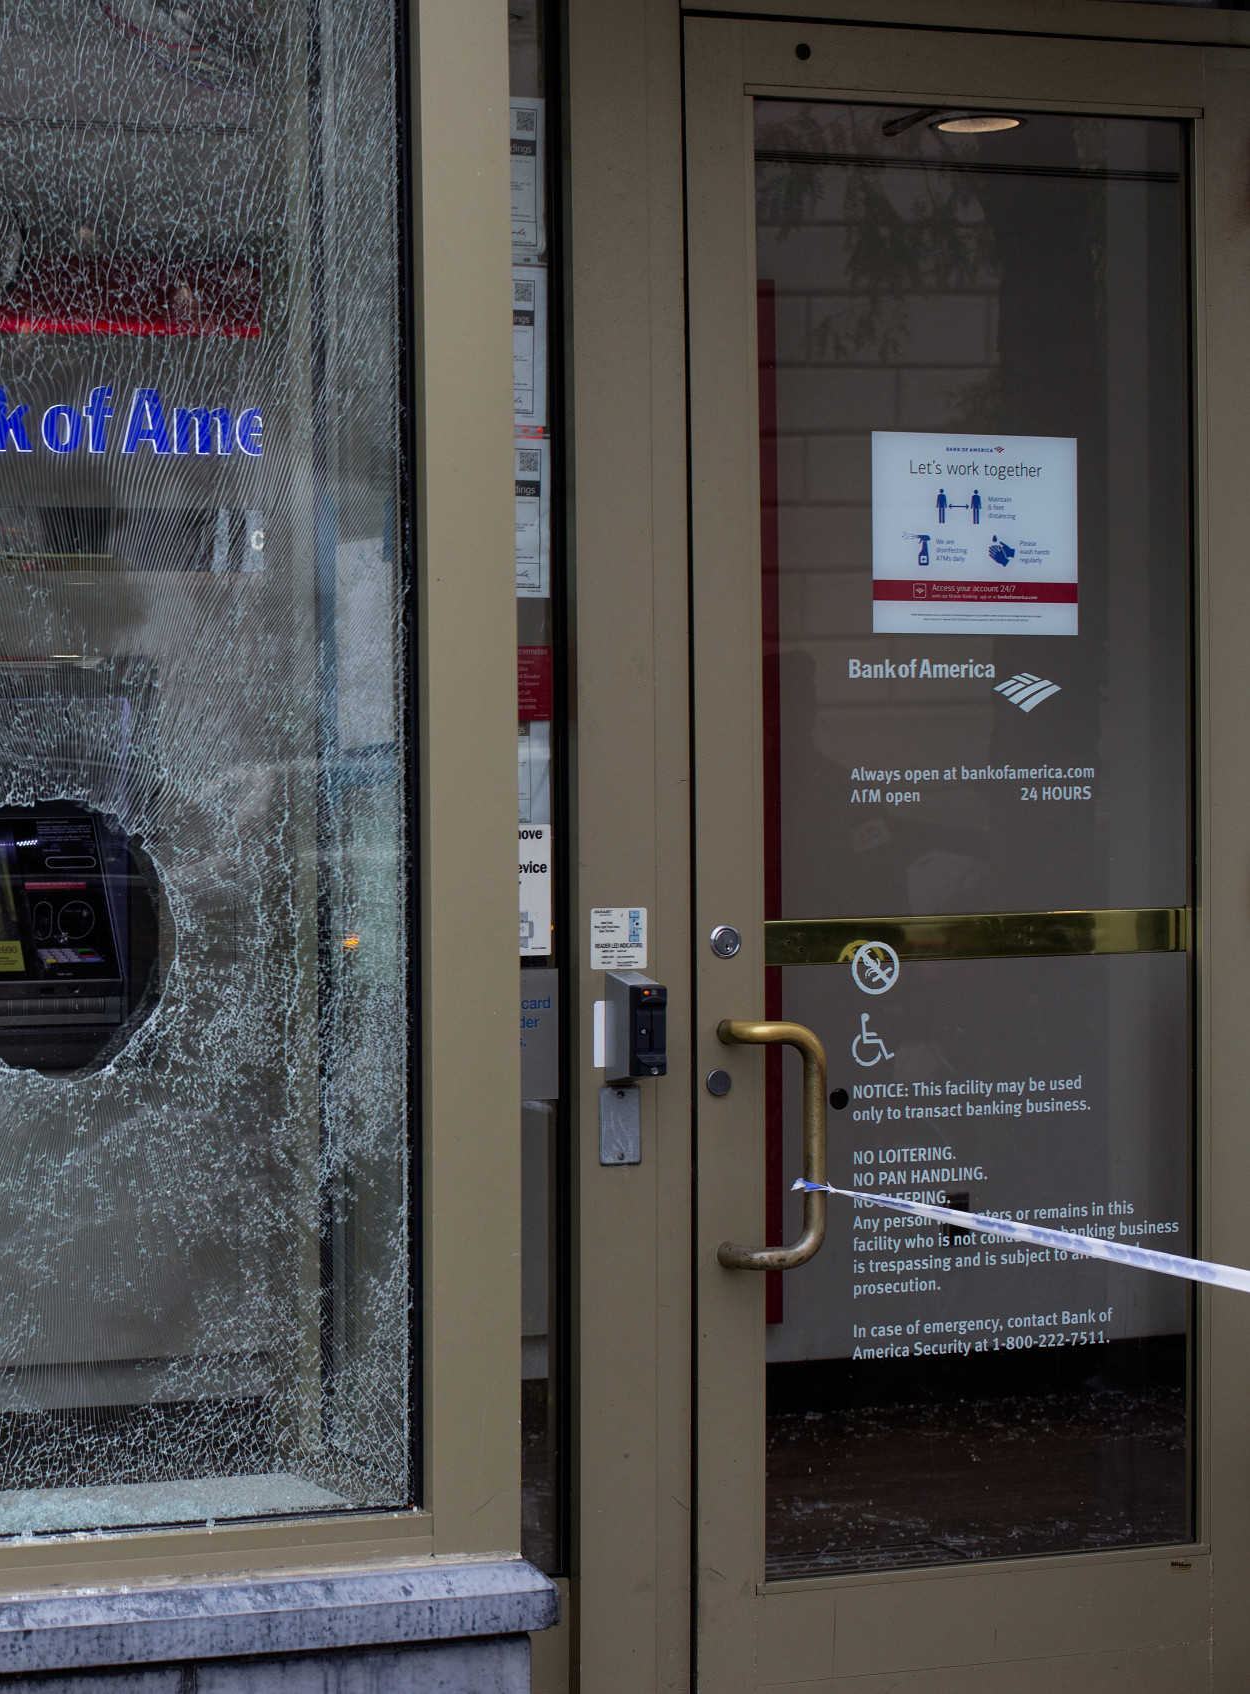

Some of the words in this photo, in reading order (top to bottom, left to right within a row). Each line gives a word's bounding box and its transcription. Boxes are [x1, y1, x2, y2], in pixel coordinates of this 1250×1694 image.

[41, 384, 113, 456] of
[910, 460, 942, 474] Let's
[947, 462, 979, 475] work
[984, 463, 1041, 480] together
[932, 584, 955, 592] Access
[849, 659, 896, 678] Bank
[898, 659, 917, 678] of
[919, 659, 995, 678] America
[851, 767, 900, 784] Always
[905, 770, 939, 784] open
[944, 767, 957, 780] at
[962, 765, 1094, 779] bankofamerica.com
[886, 792, 920, 805] open
[1021, 788, 1038, 800] 24
[1043, 786, 1091, 800] HOURS
[522, 996, 551, 1011] card
[854, 1084, 908, 1098] NOTICE:
[913, 1082, 941, 1096] This
[946, 1080, 993, 1097] facility
[997, 1082, 1025, 1095] may
[1030, 1077, 1045, 1091] be
[1050, 1075, 1081, 1090] used
[853, 1106, 883, 1123] only
[887, 1107, 901, 1119] to
[905, 1104, 962, 1118] transact
[967, 1100, 1022, 1117] banking
[1027, 1098, 1090, 1113] business.
[854, 1151, 874, 1164] NO
[879, 1147, 956, 1163] LOITERING.
[854, 1172, 874, 1186] NO
[879, 1171, 906, 1185] PAN
[912, 1167, 987, 1183] HANDLING.
[853, 1216, 880, 1232] Any
[884, 1217, 931, 1235] person
[1016, 1210, 1030, 1220] or
[1034, 1204, 1087, 1219] remains
[1092, 1202, 1103, 1216] in
[1108, 1200, 1134, 1215] this
[854, 1236, 901, 1253] facility
[905, 1234, 933, 1248] who
[939, 1233, 949, 1246] is
[954, 1232, 976, 1245] not
[1120, 1220, 1179, 1235] business
[854, 1259, 865, 1273] is
[869, 1250, 951, 1274] trespassing
[956, 1252, 980, 1267] and
[986, 1252, 996, 1265] is
[1001, 1246, 1051, 1266] subject
[1054, 1247, 1068, 1262] to
[854, 1277, 940, 1298] prosecution.
[854, 1325, 866, 1337] In
[871, 1325, 902, 1337] case
[907, 1320, 920, 1334] of
[924, 1319, 1003, 1334] emergency,
[1008, 1313, 1057, 1328] contact
[1062, 1309, 1096, 1324] Bank
[1099, 1308, 1113, 1322] of
[853, 1343, 909, 1359] America
[914, 1339, 971, 1356] Security
[975, 1339, 988, 1352] at
[992, 1328, 1109, 1350] 1-800-222-7511.
